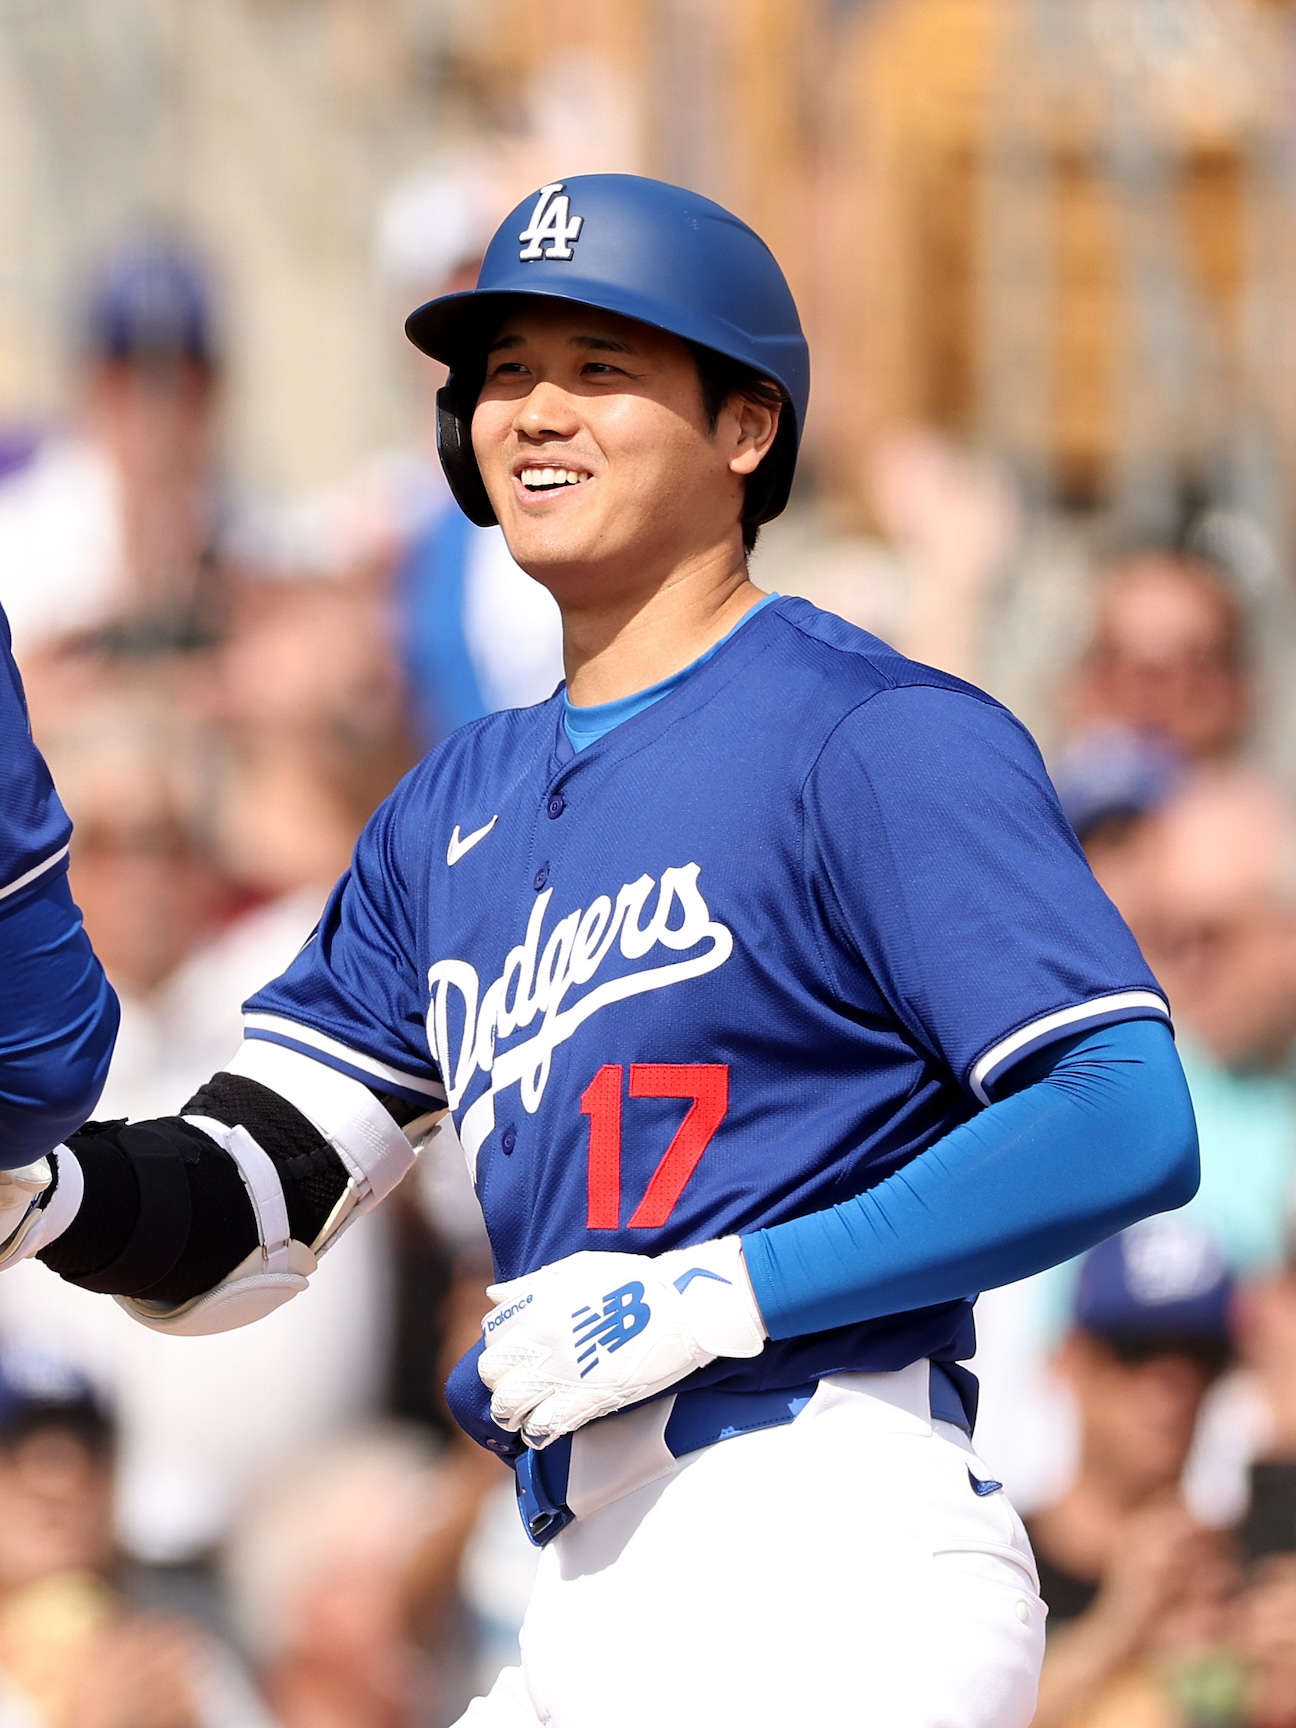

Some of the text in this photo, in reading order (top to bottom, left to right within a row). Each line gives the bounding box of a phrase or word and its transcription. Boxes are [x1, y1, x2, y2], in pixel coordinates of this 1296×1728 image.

[518, 183, 583, 260] LA
[425, 861, 734, 1114] Dodgers
[579, 1063, 730, 1230] 17
[487, 1294, 534, 1333] balance
[571, 1280, 651, 1379] NB
